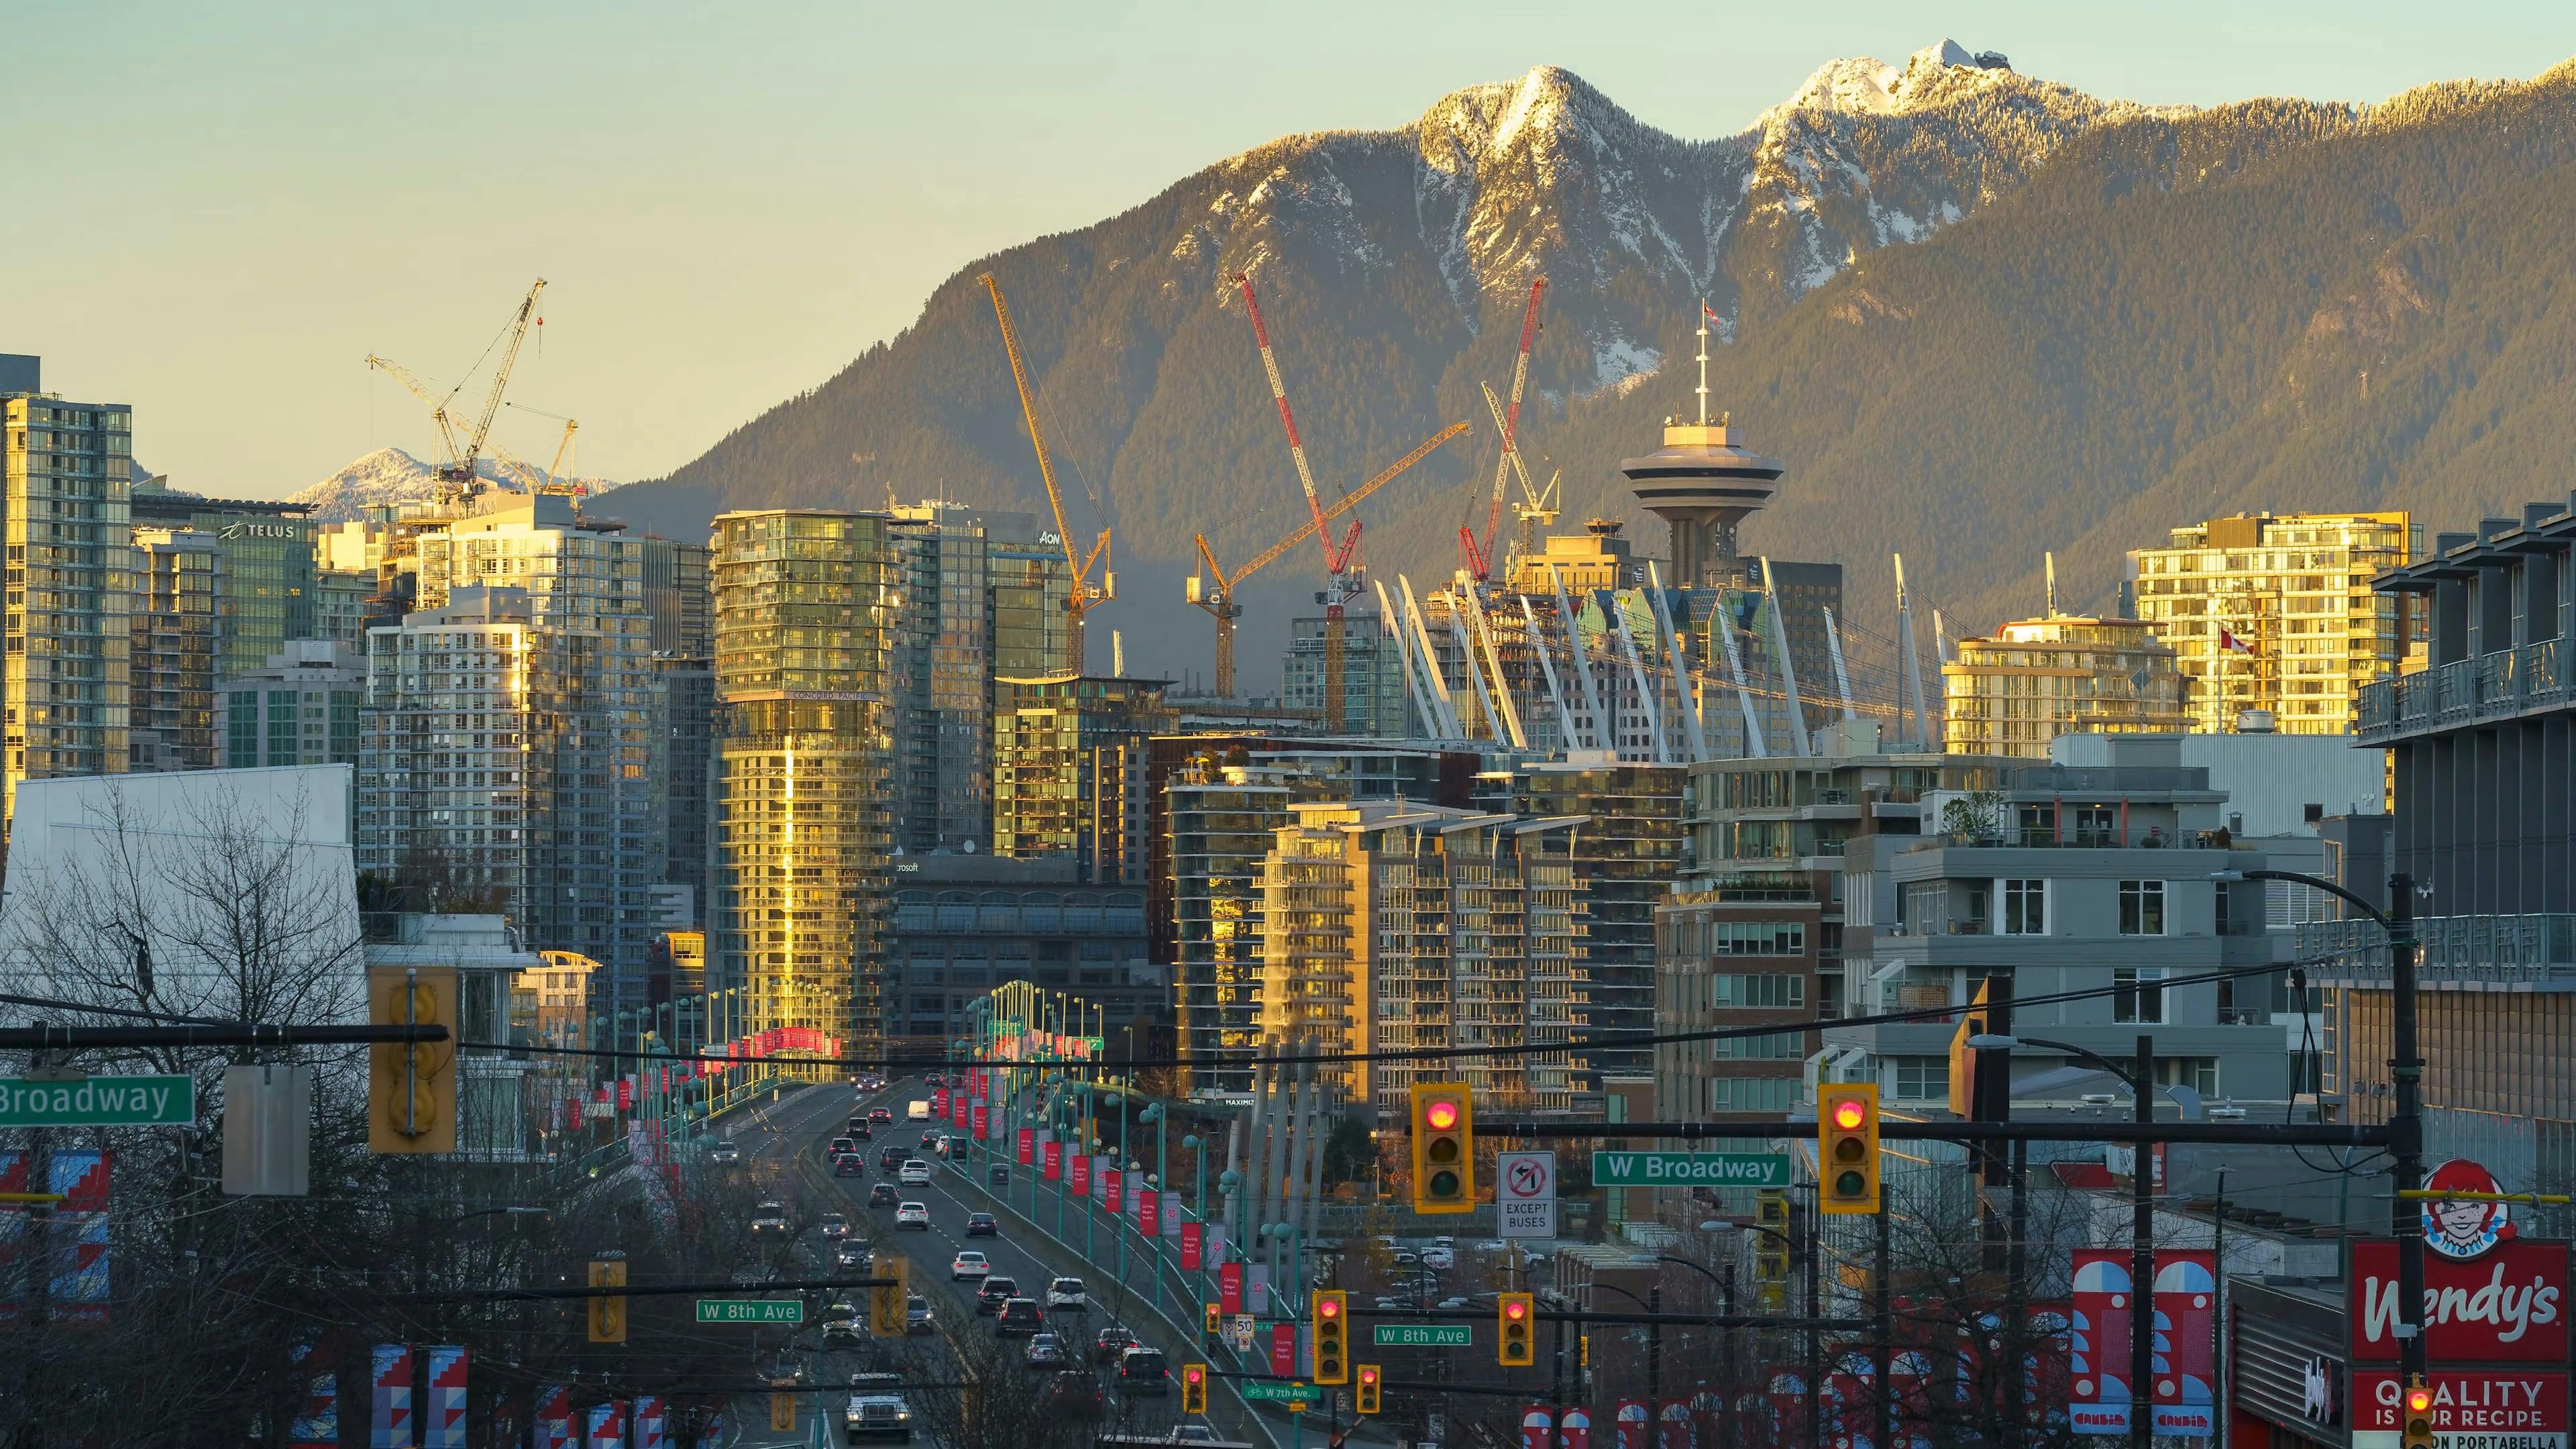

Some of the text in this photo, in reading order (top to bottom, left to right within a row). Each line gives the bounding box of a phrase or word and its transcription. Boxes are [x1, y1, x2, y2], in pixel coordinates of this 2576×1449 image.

[248, 525, 294, 538] TELUS
[1608, 1157, 1776, 1182] W Broadway
[1507, 1203, 1548, 1214] EXCEPT
[1509, 1218, 1546, 1228] BUSES
[704, 1304, 795, 1319] W 8th Ave
[1237, 1320, 1252, 1332] 50
[1381, 1329, 1464, 1342] W 8th Ave
[1266, 1388, 1311, 1397] W 7th Ave.
[2375, 1380, 2543, 1409] QALITY
[2376, 1409, 2395, 1426] IS
[2457, 1436, 2557, 1449] PORTABELLA
